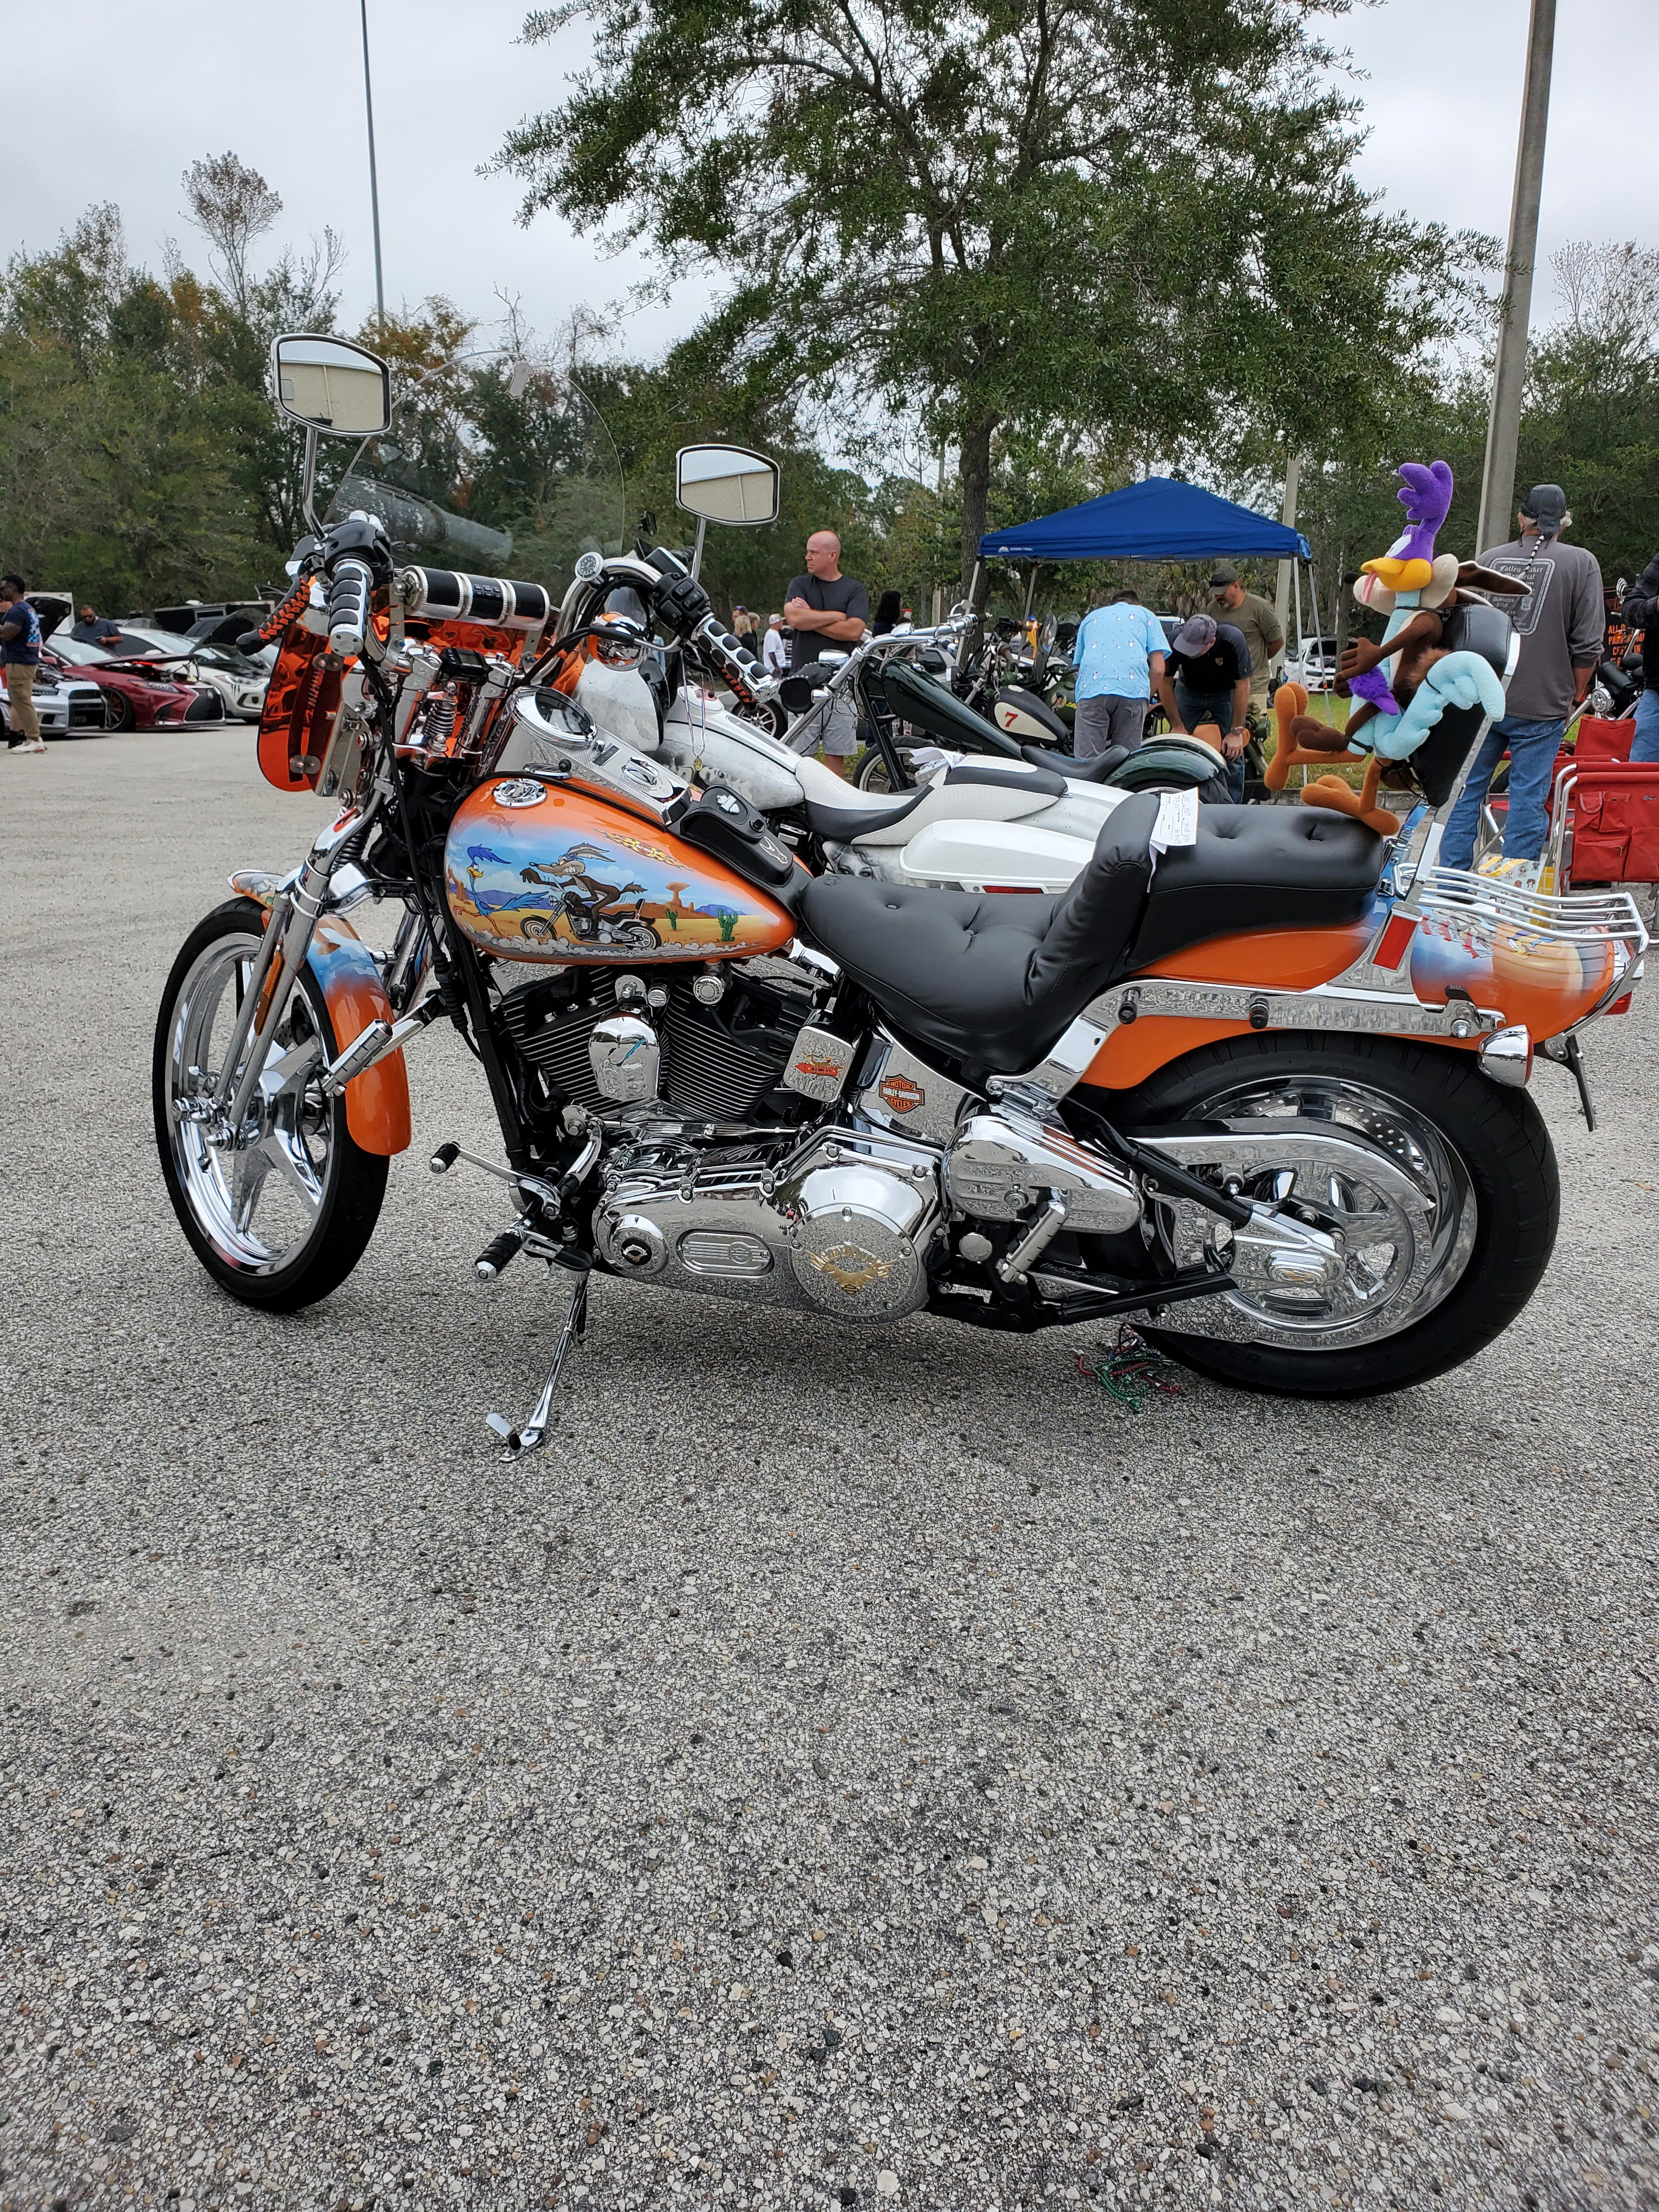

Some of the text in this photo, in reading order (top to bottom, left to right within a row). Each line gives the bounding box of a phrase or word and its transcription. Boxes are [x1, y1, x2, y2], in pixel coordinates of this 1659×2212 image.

[1005, 712, 1018, 727] 7
[890, 1080, 911, 1090] MOTOR
[883, 1086, 920, 1101] HARLEY-DAVIDSON
[890, 1098, 911, 1109] CYCLES
